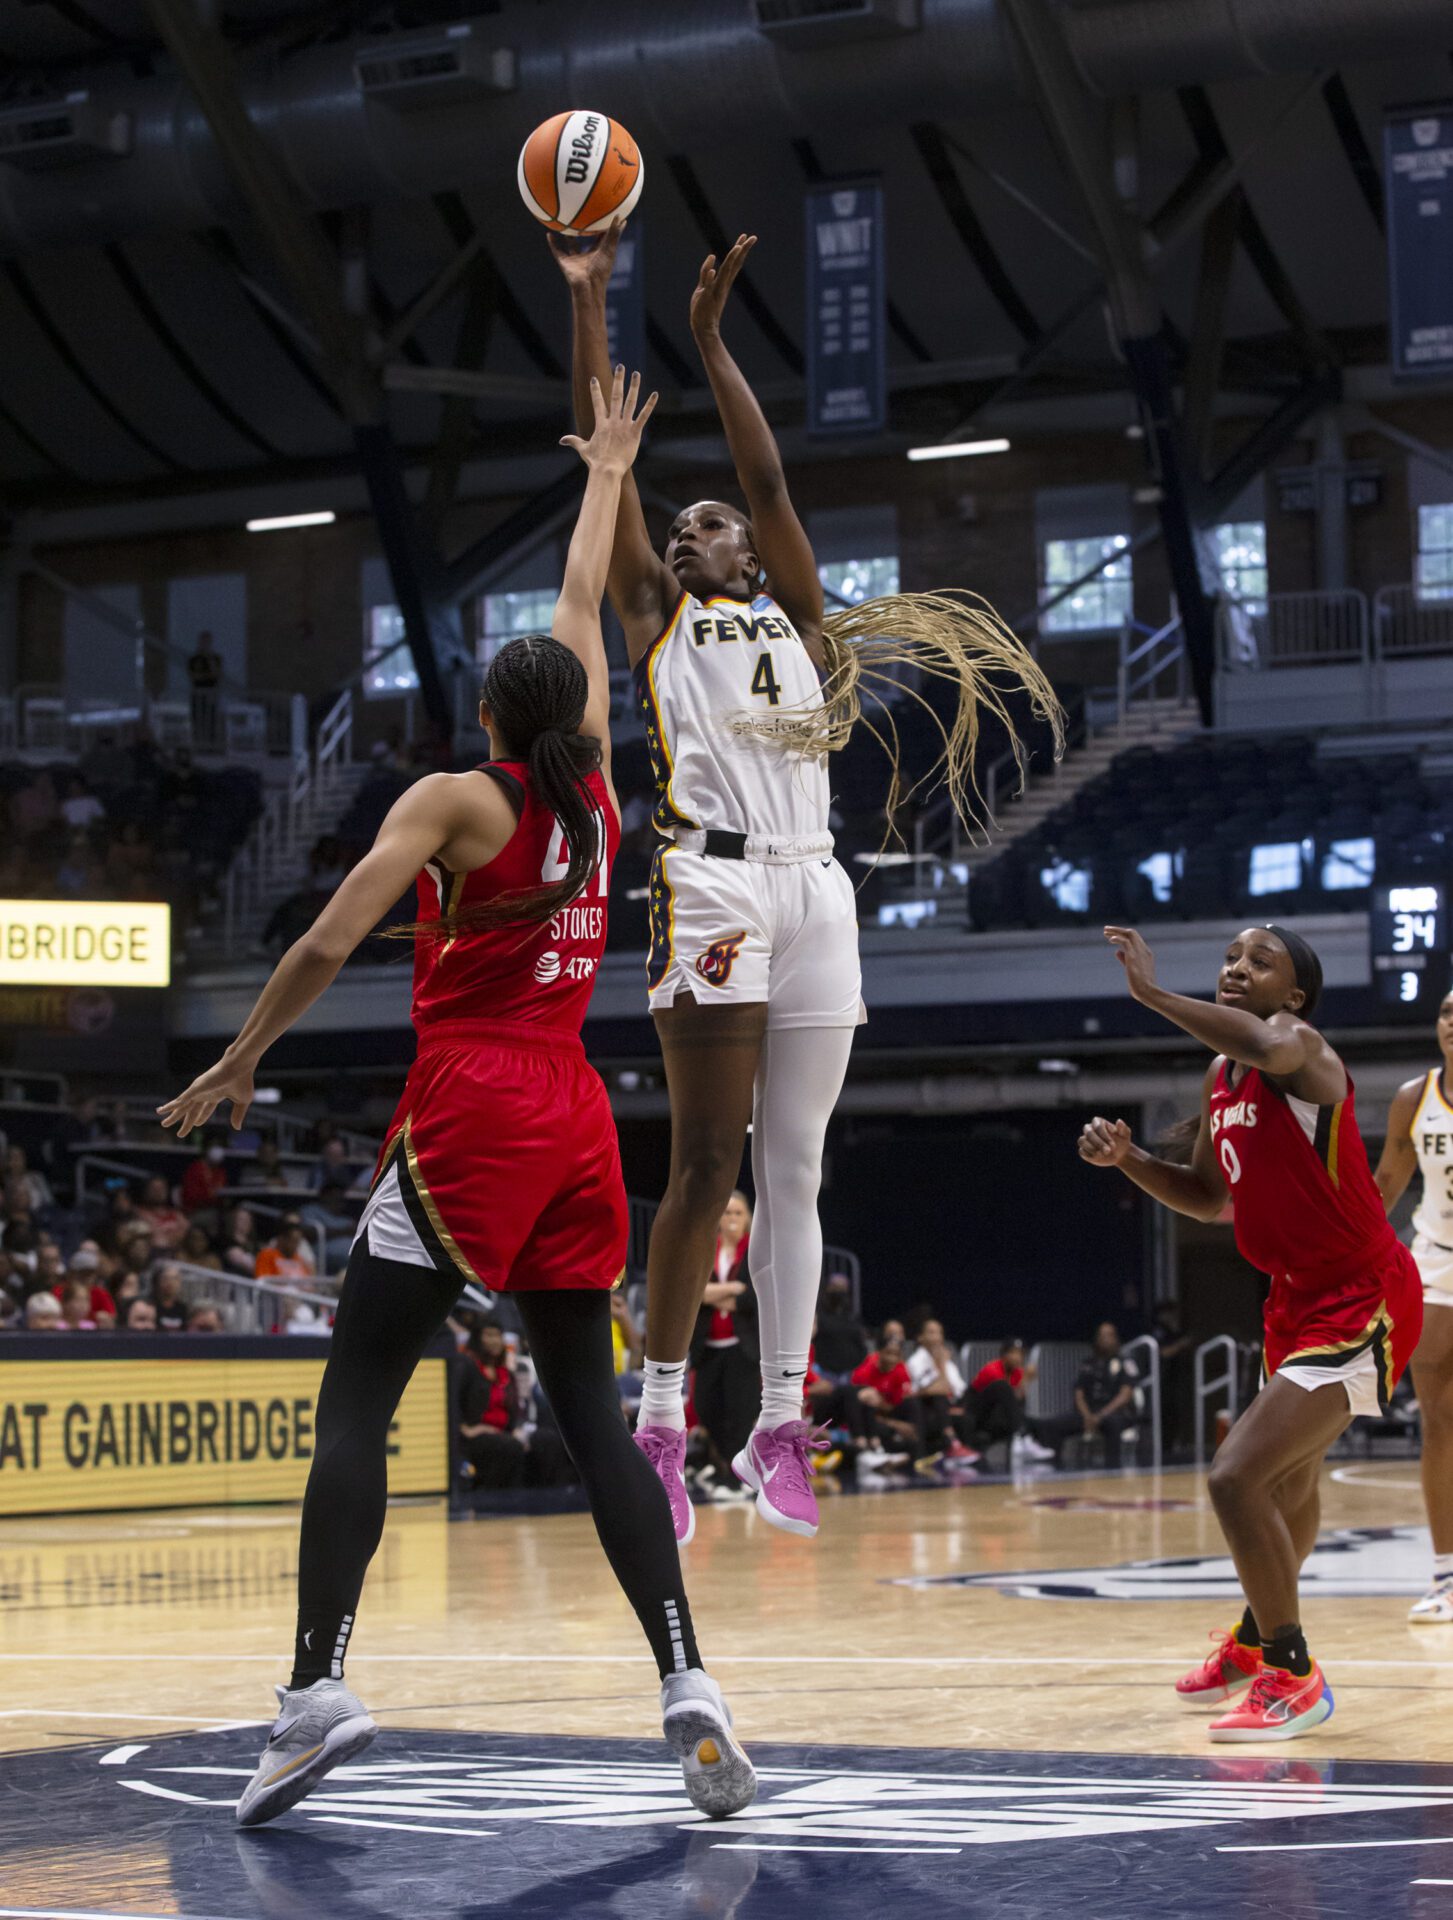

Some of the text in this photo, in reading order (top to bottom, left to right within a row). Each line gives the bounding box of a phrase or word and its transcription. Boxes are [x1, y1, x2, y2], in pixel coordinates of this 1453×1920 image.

[564, 115, 600, 184] Wilson
[693, 614, 799, 647] FEVER
[751, 652, 781, 706] 4
[541, 806, 607, 899] 41
[0, 923, 148, 962] BRIDGE
[550, 907, 602, 941] STOKES
[1392, 913, 1436, 951] 34
[561, 956, 598, 981] AT&
[1400, 971, 1418, 1001] 3
[1221, 1138, 1242, 1184] 0
[1423, 1133, 1453, 1155] FE
[0, 1402, 48, 1469] AT
[63, 1399, 313, 1469] GAINBRIDGE
